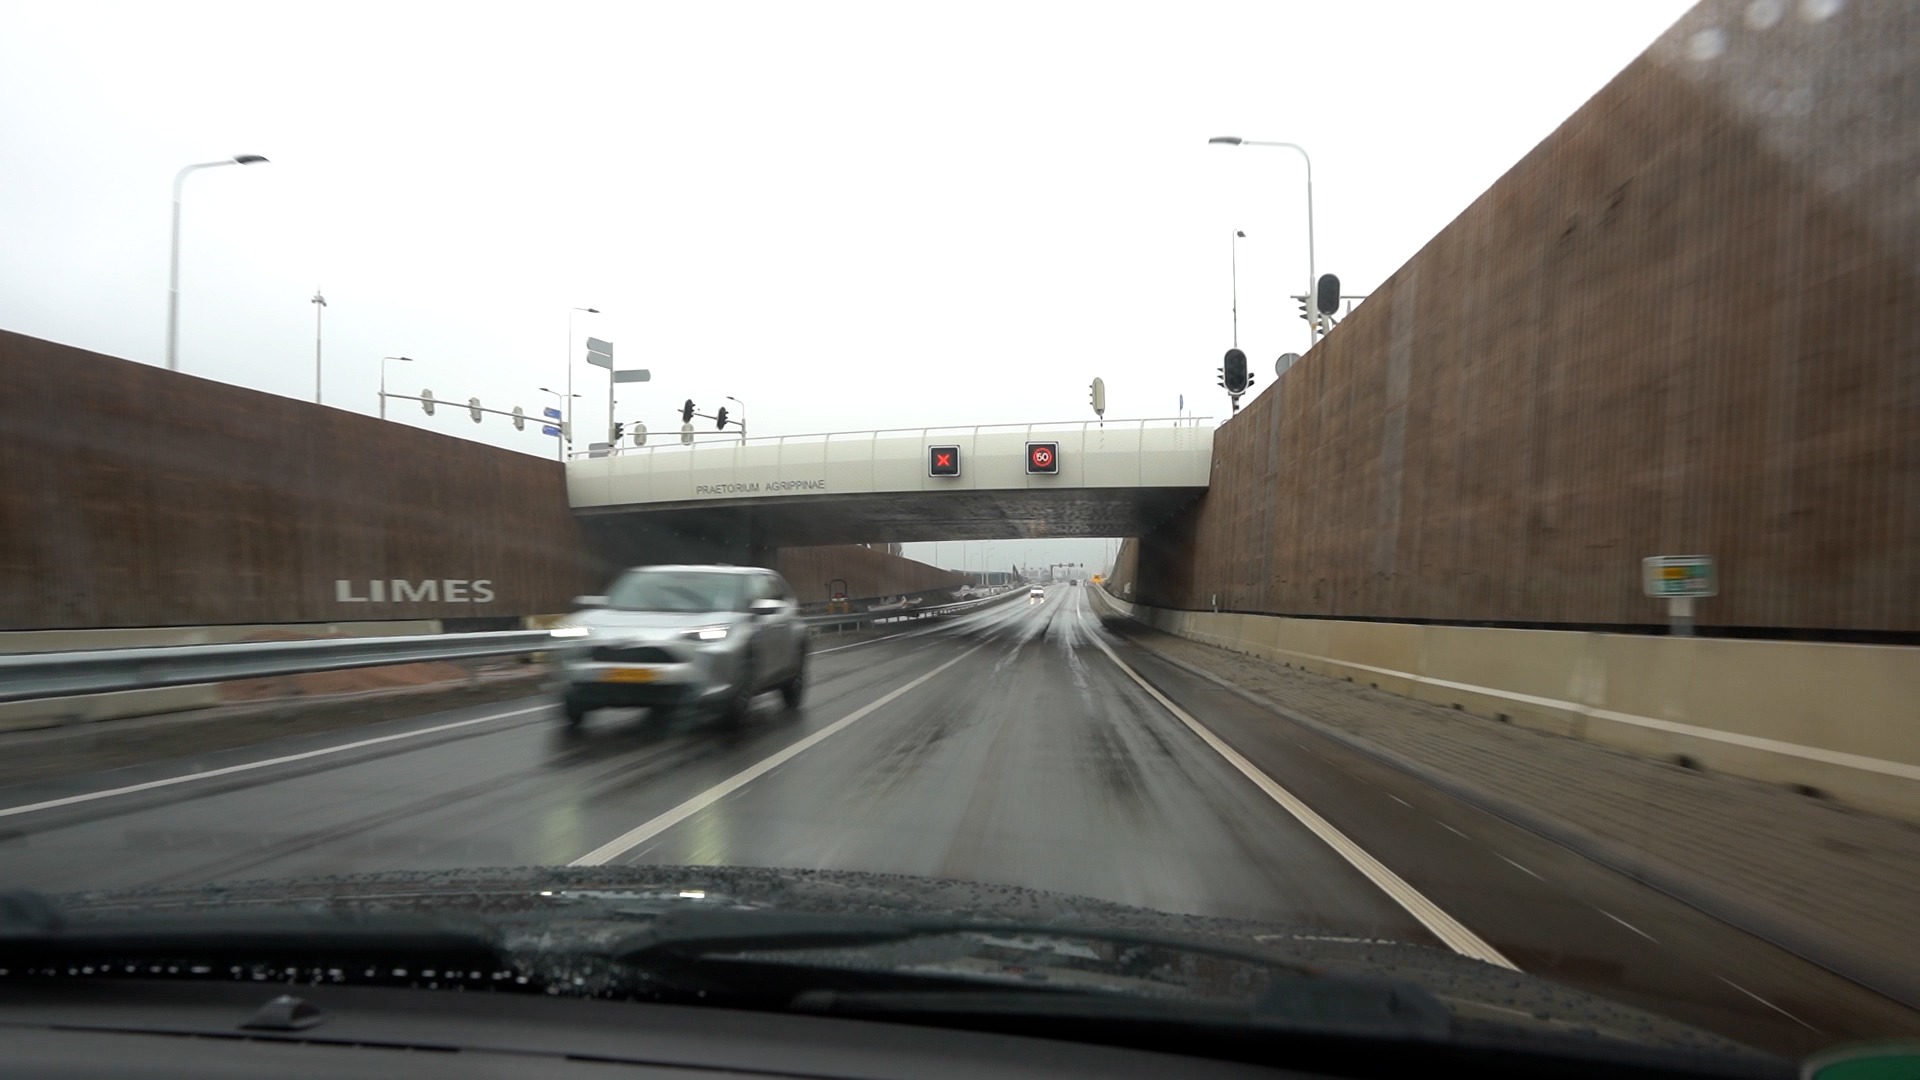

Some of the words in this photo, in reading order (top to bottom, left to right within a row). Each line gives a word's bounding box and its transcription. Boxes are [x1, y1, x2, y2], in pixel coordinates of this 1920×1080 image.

[696, 483, 759, 495] PRAETORIUM
[765, 480, 825, 491] AGRIPPINAE
[335, 579, 495, 603] LIMES
